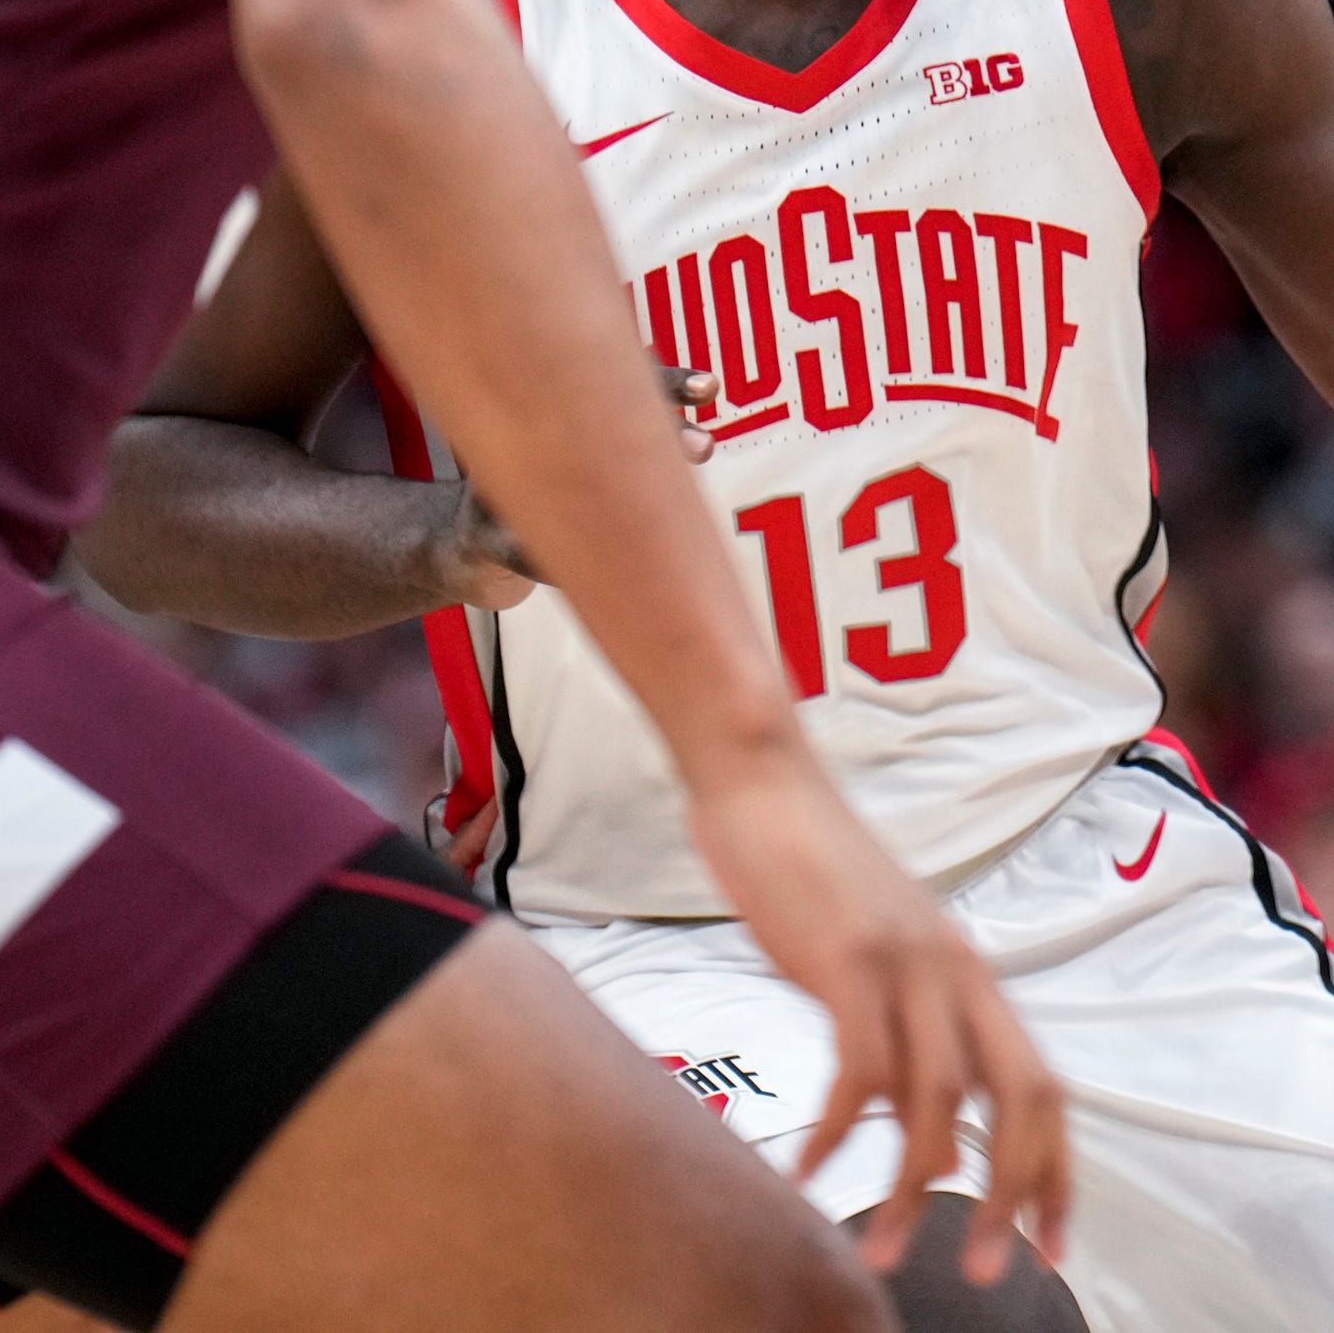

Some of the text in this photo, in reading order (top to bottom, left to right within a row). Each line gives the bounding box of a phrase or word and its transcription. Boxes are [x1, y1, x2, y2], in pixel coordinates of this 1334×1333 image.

[777, 185, 1088, 443] STATE
[736, 463, 967, 703] 13
[679, 1055, 779, 1098] ATE
